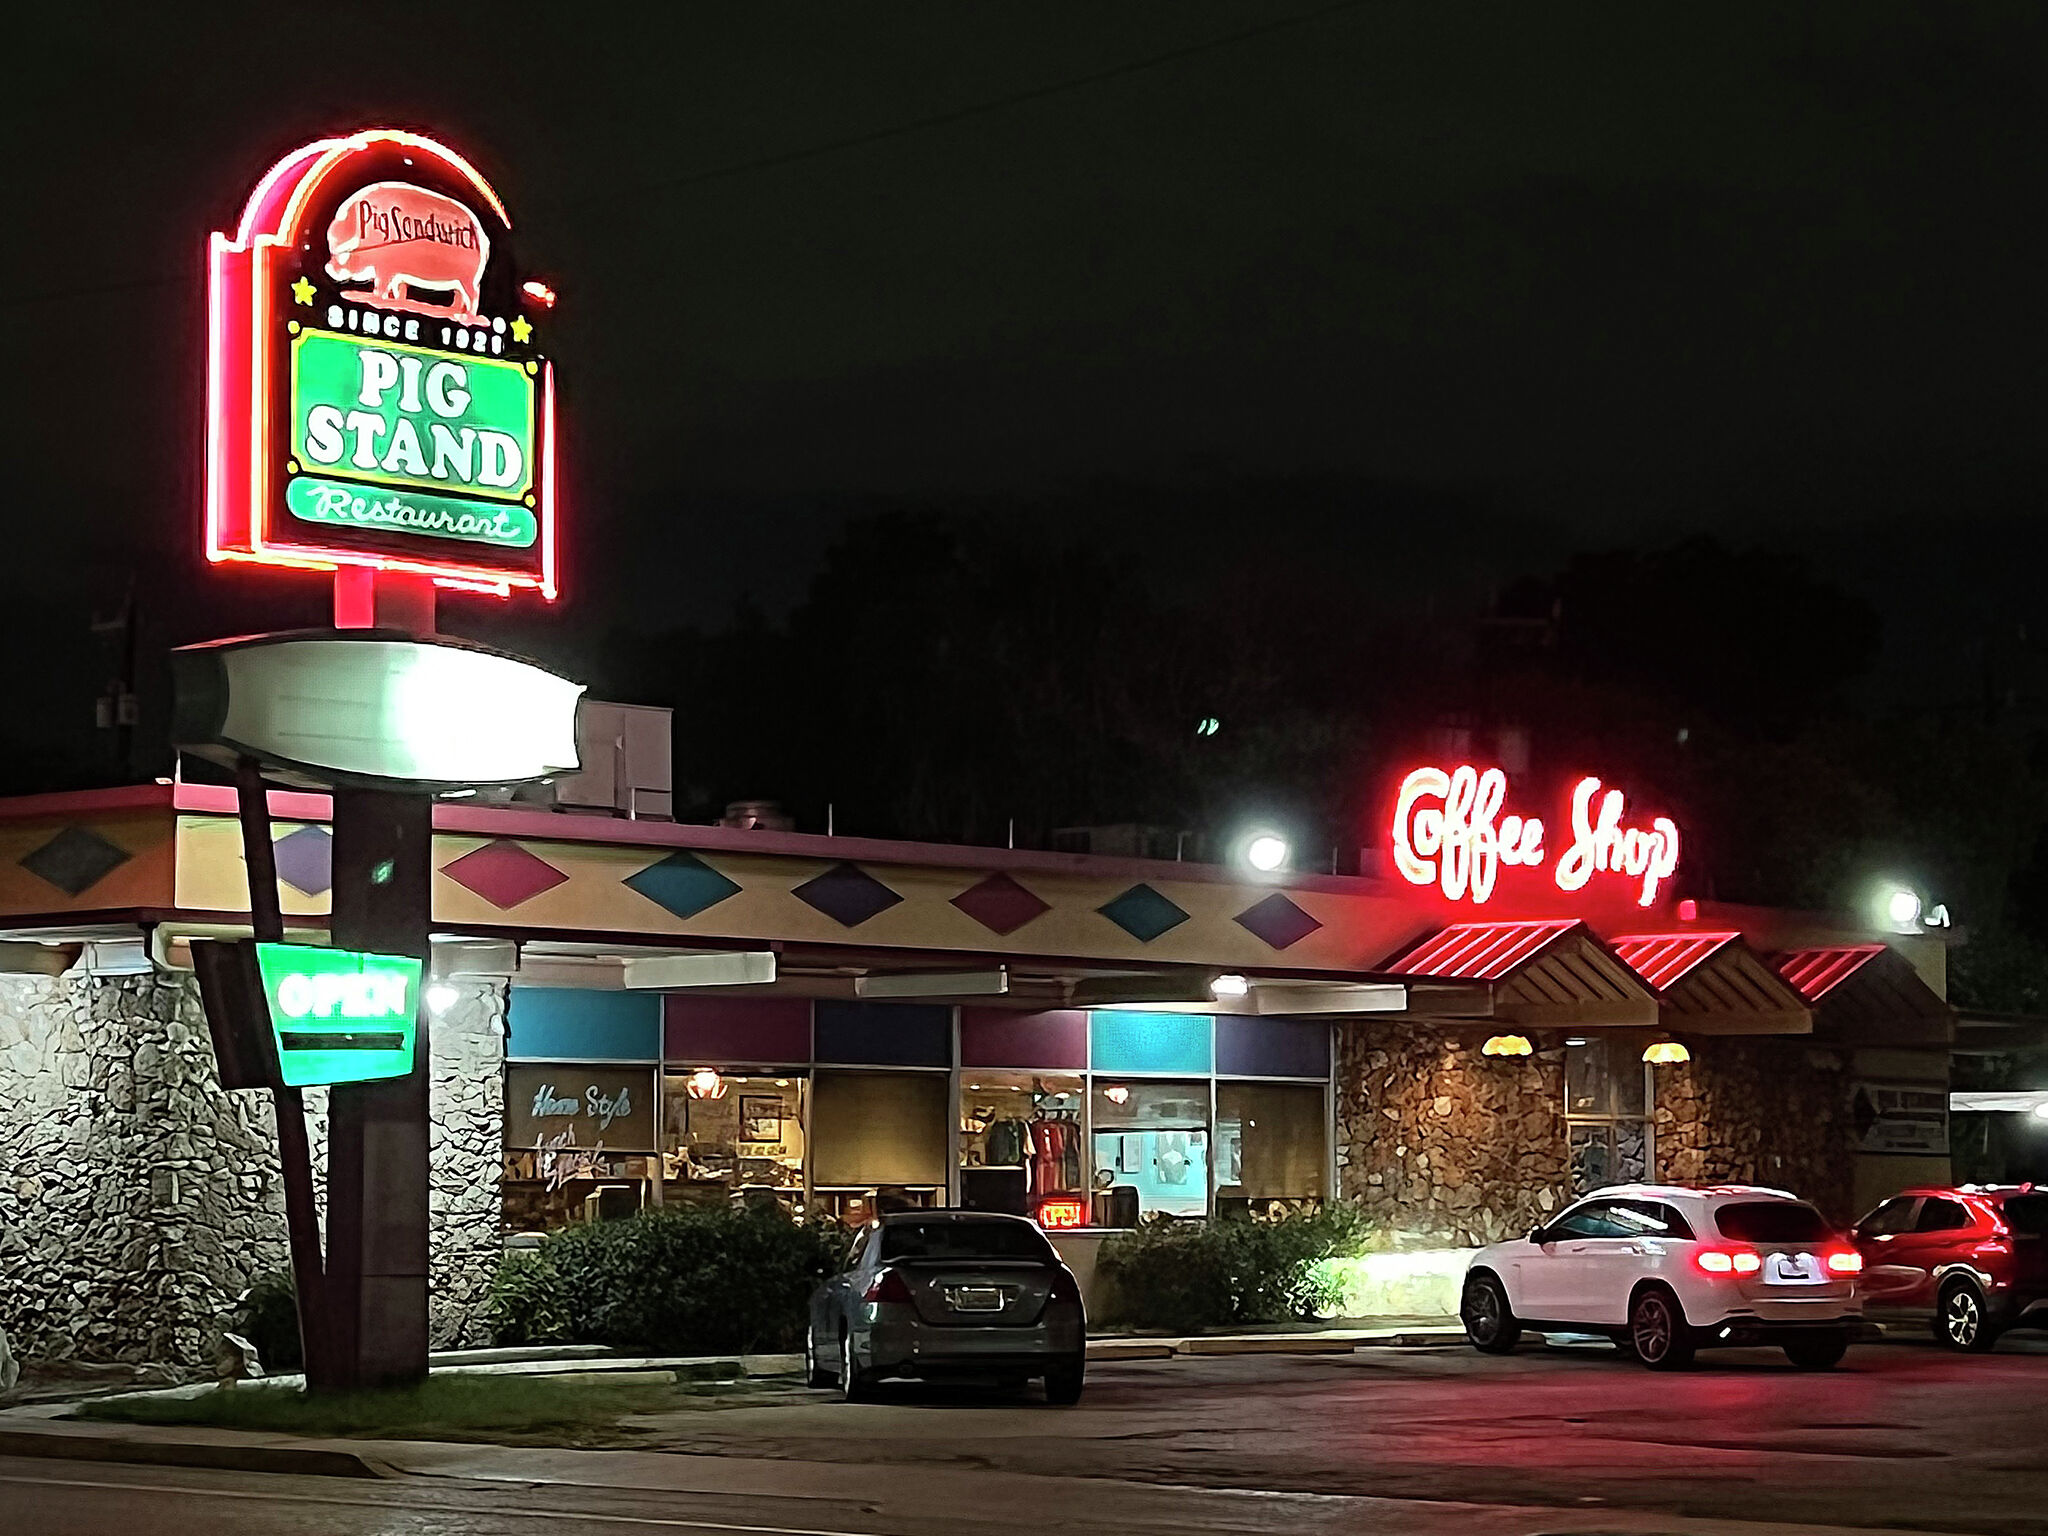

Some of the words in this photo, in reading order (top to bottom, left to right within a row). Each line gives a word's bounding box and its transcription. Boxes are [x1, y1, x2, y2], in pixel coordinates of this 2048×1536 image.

[359, 199, 390, 242] Pig
[327, 304, 420, 341] SINCE
[358, 350, 471, 418] PIG
[304, 404, 522, 488] STAND
[306, 485, 521, 538] Restaurant
[1393, 765, 1545, 904] Coffee
[1555, 776, 1679, 907] Shop
[277, 973, 408, 1018] OPEN
